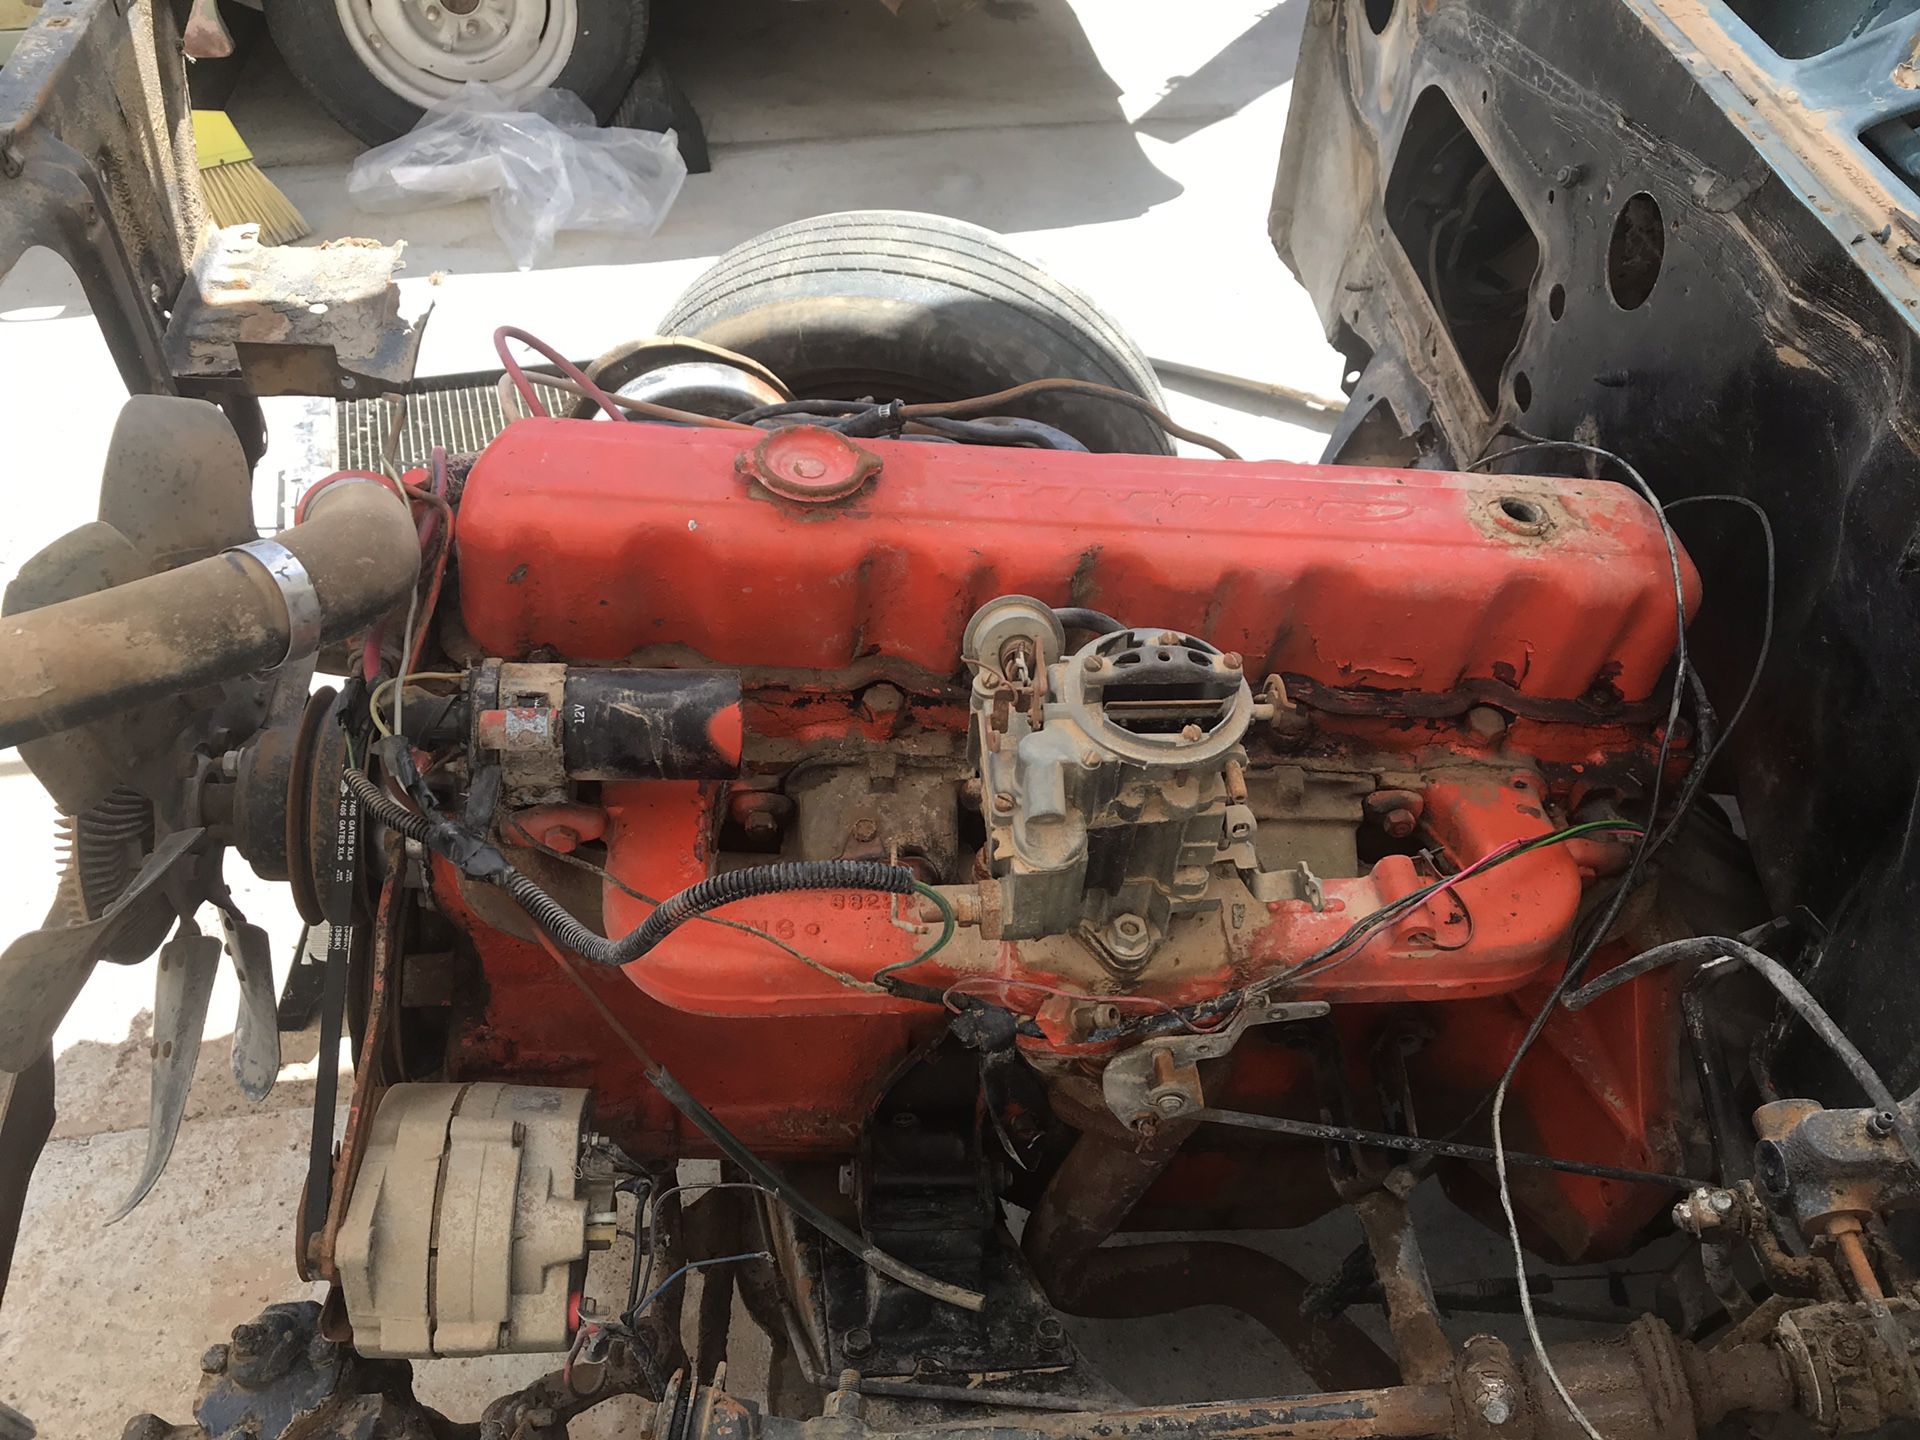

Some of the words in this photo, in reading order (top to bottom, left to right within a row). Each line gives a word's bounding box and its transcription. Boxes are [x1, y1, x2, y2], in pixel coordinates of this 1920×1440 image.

[574, 704, 585, 723] 12V
[338, 820, 346, 845] GATES
[348, 820, 356, 845] GATES
[333, 925, 342, 950] (358K)
